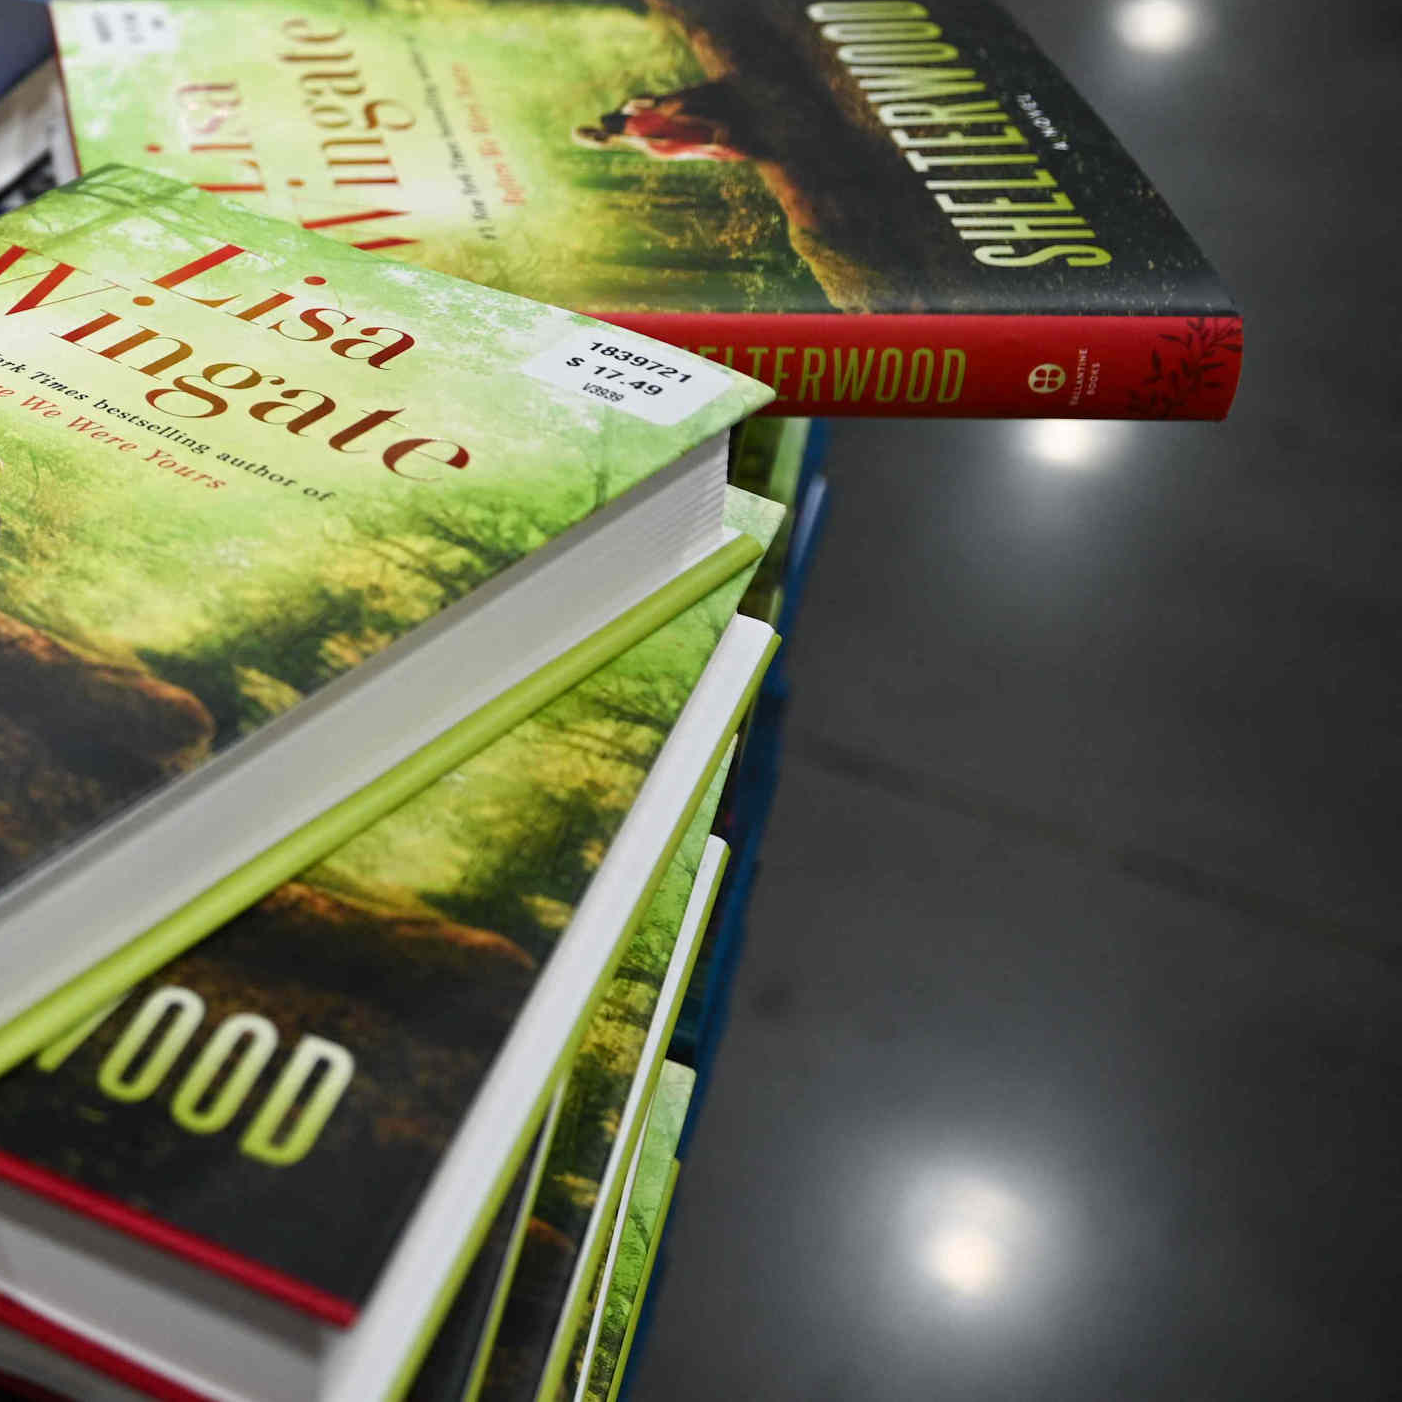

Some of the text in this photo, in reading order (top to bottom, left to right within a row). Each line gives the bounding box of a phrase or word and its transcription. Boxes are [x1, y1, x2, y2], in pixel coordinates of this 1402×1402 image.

[146, 81, 268, 195] Lisa
[280, 17, 422, 251] Wingate
[806, 0, 1113, 267] SHELTERWOOD
[1017, 93, 1058, 138] NOVEL
[138, 244, 417, 371] Lisa
[581, 381, 626, 403] V3939
[587, 341, 693, 385] 1839721
[592, 364, 664, 398] 17.49
[19, 394, 64, 420] We
[66, 415, 140, 453] Were
[141, 447, 228, 491] Yours
[27, 369, 91, 402] Times
[91, 397, 212, 456] bestselling
[215, 450, 299, 488] author
[302, 485, 338, 503] of
